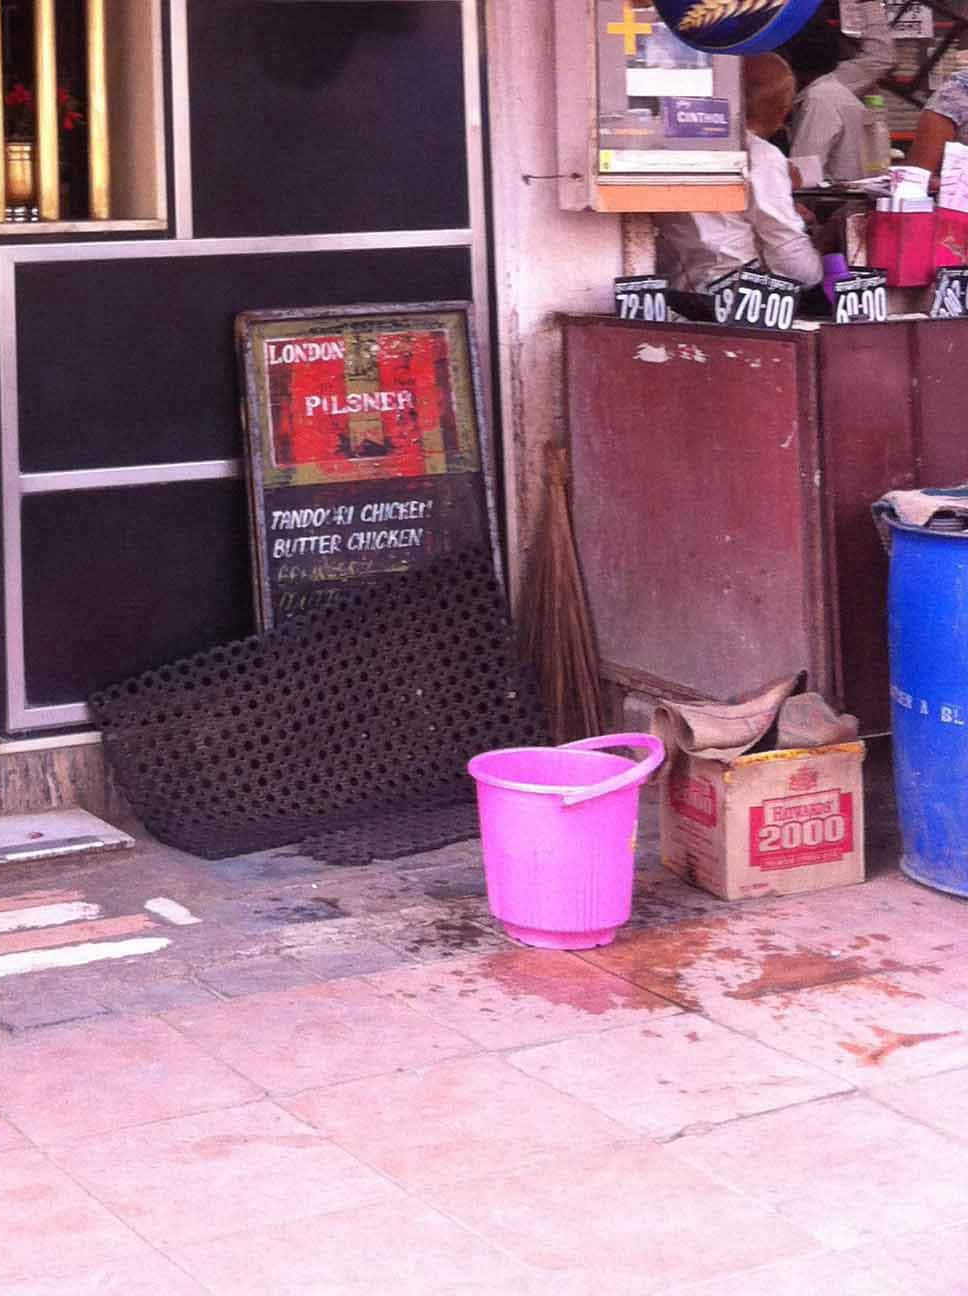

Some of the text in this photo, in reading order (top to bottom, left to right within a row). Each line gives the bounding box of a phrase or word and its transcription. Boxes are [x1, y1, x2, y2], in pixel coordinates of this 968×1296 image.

[734, 286, 795, 331] 70-00
[268, 340, 346, 365] LONDON
[305, 390, 415, 416] PILSNER
[273, 527, 424, 558] BUTTER CHICKEN
[759, 813, 845, 852] 2000
